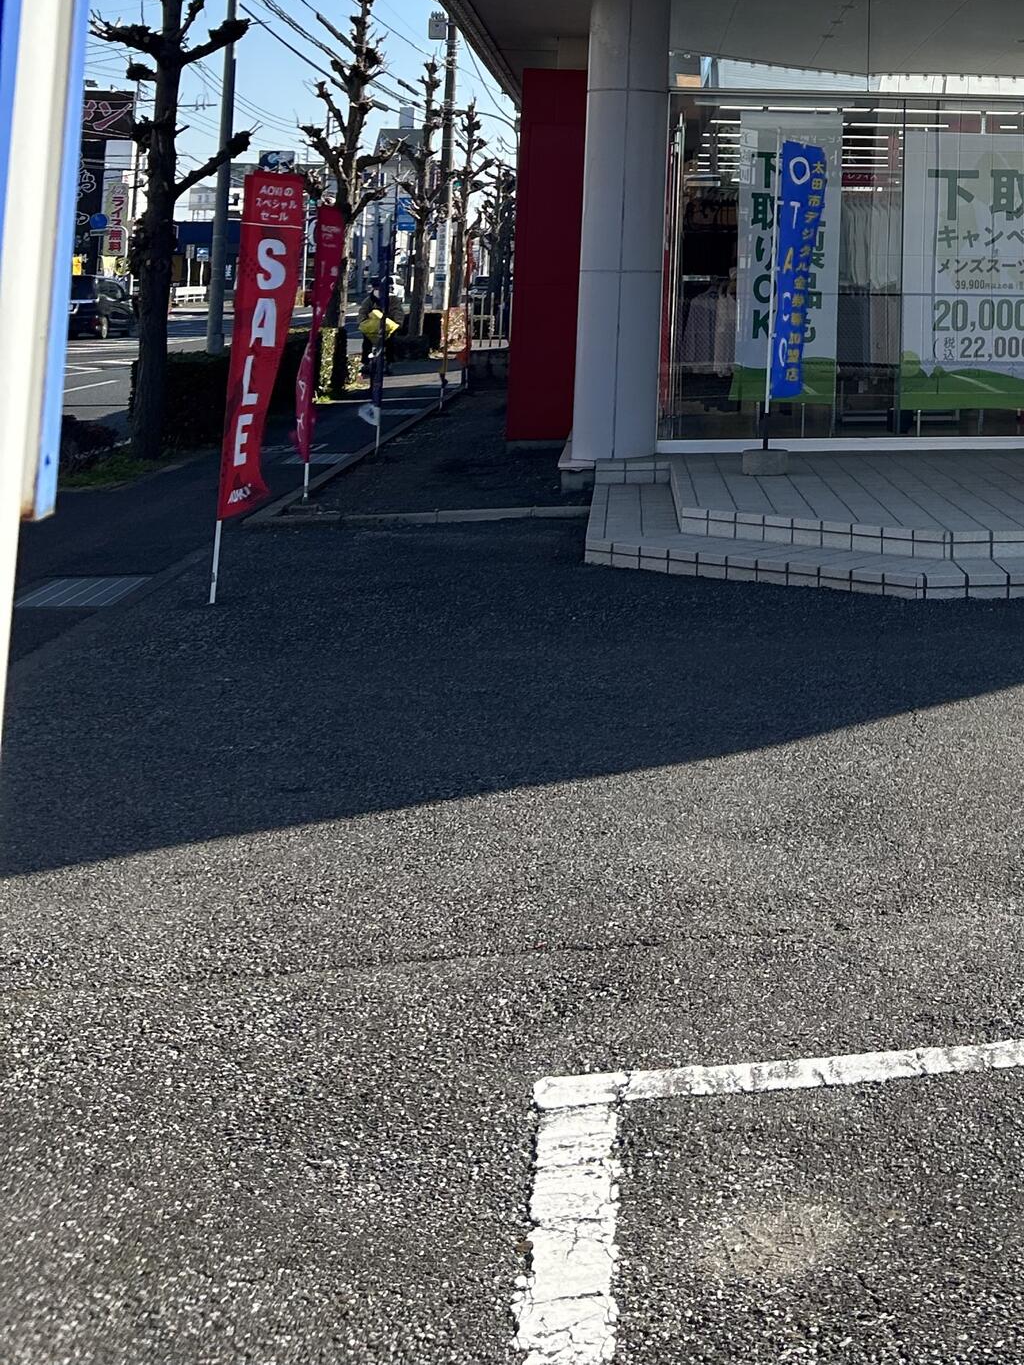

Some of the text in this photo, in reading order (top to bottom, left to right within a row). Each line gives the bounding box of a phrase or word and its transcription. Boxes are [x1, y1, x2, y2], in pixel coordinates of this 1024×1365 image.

[255, 197, 297, 210] スペシャル
[260, 211, 289, 222] セール
[233, 238, 287, 467] SALE
